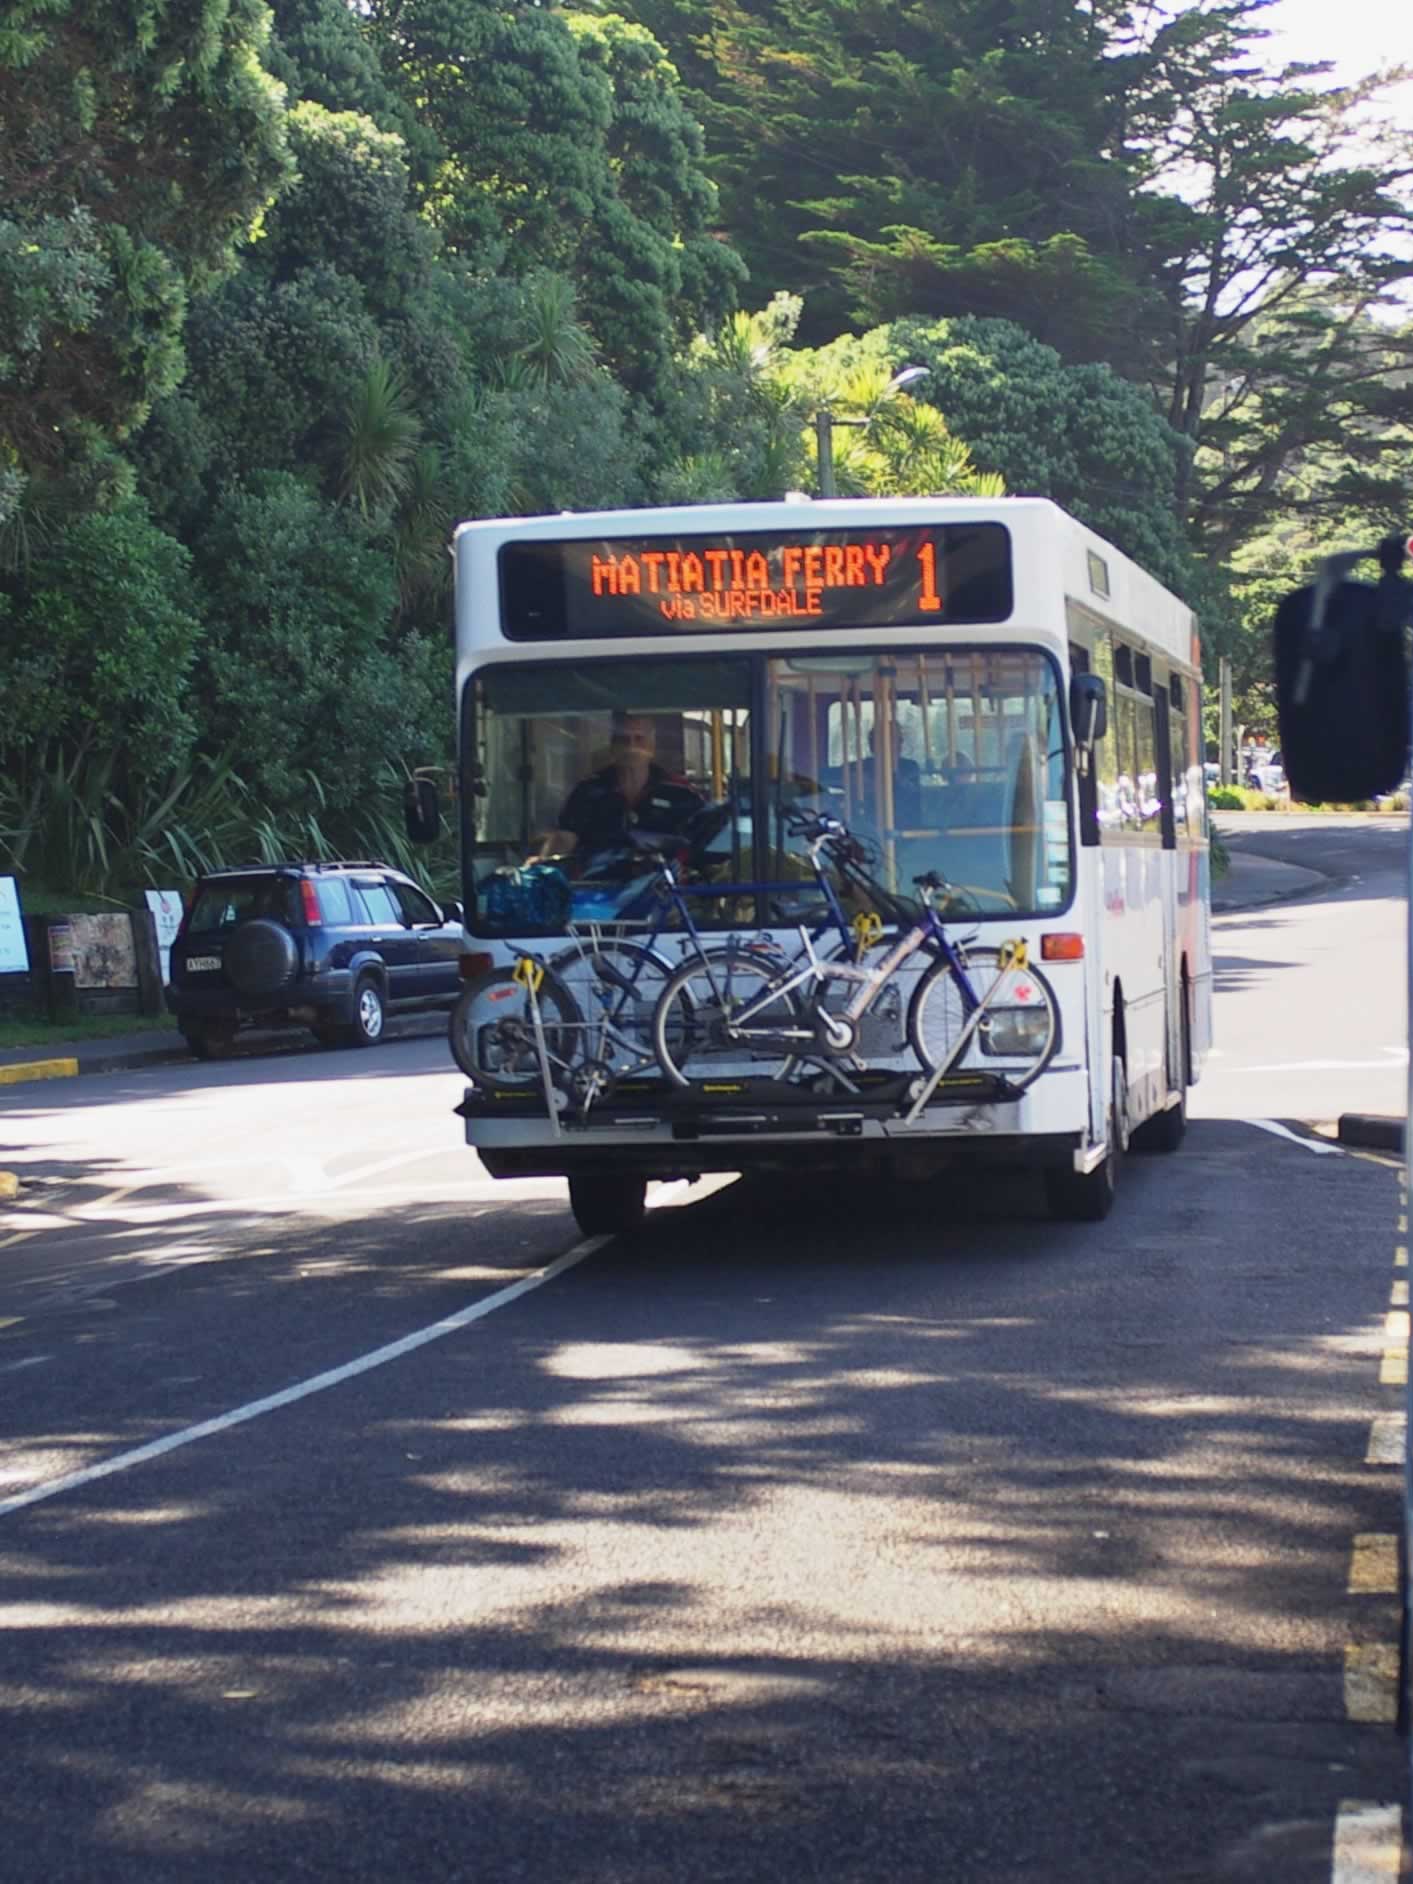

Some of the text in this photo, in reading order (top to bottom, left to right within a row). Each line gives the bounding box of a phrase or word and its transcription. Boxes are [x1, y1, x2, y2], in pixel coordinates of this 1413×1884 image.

[592, 543, 891, 595] MATIATIA FERRY
[917, 541, 942, 611] 1
[660, 586, 824, 620] via SURFDALE
